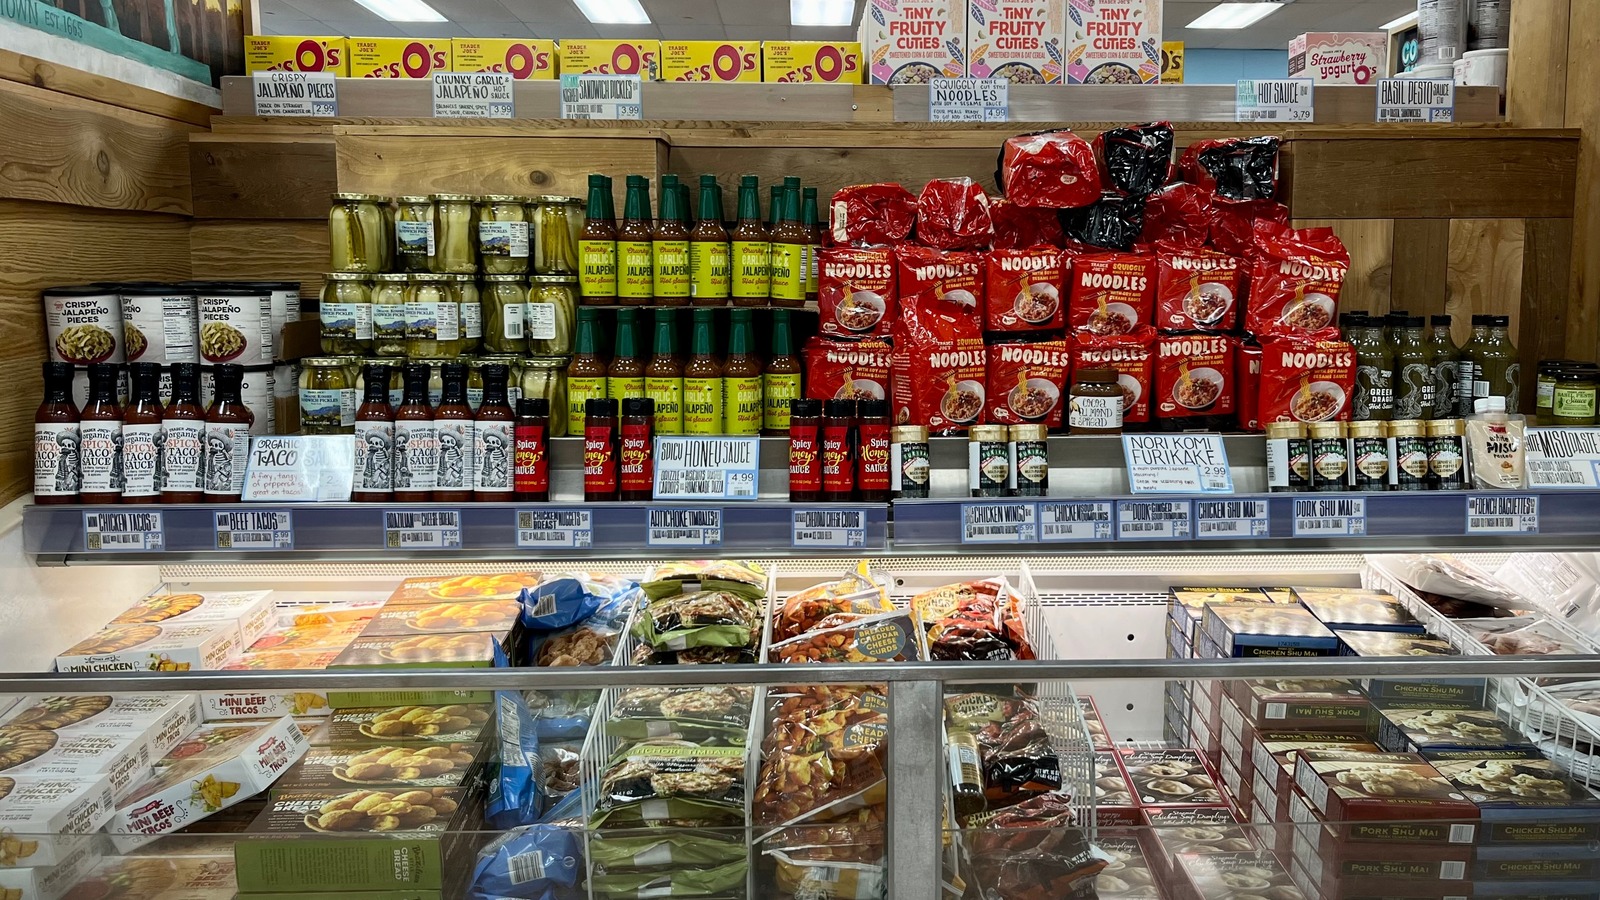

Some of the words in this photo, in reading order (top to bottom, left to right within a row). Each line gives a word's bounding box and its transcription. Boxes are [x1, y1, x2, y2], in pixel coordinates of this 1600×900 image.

[63, 14, 84, 39] 1665
[888, 51, 911, 59] SWEETENED
[1310, 49, 1368, 67] Strawberry
[1320, 61, 1356, 80] yogurt
[271, 73, 307, 82] CRISPY
[435, 75, 472, 84] CHUNKY
[475, 75, 504, 85] GARLIC
[579, 79, 610, 100] SANDWICH
[610, 79, 633, 100] PICKLES
[933, 79, 977, 90] SQUIGGLY
[257, 82, 305, 99] JALAPEÑO
[307, 83, 335, 99] PIECES
[436, 85, 488, 99] JALAPEÑO
[936, 89, 998, 102] NOODLES
[1258, 82, 1273, 104] HOT
[1274, 82, 1299, 104] SAUCE
[1381, 80, 1406, 105] BASIL
[1408, 81, 1433, 105] PESTO
[316, 104, 334, 113] 2.99
[494, 104, 512, 113] 3.99
[621, 106, 639, 114] 3.99
[988, 108, 1006, 117] 4.99
[1434, 109, 1452, 118] 2.99
[1293, 110, 1311, 119] 3.79
[584, 255, 608, 265] GARLIC
[825, 262, 892, 280] NOODLES
[1081, 272, 1147, 292] NOODLES
[65, 301, 98, 309] CRISPY
[61, 306, 109, 317] JALAPEÑO
[67, 315, 99, 324] PIECES
[1160, 339, 1228, 357] NOODLES
[1281, 350, 1352, 370] NOODLES
[82, 440, 110, 449] SPICY
[124, 444, 153, 453] SPICY
[167, 439, 197, 448] SPICY
[257, 439, 300, 450] ORGANIC
[517, 439, 538, 451] Spicy
[624, 438, 645, 450] Spicy
[792, 438, 812, 450] Spicy
[1130, 436, 1169, 450] NORI
[1172, 436, 1212, 450] KOMI
[1537, 430, 1573, 458] MISO
[82, 448, 110, 457] TACO
[125, 452, 152, 462] TACO
[167, 447, 196, 457] TACO
[661, 442, 683, 461] SPICY
[684, 440, 722, 468] HONEY
[722, 441, 751, 464] SAUCE
[1131, 449, 1215, 466] FURIKAKE
[82, 456, 111, 466] SAUCE
[167, 456, 198, 465] SAUCE
[253, 449, 298, 467] TACO
[125, 461, 154, 470] SAUCE
[1204, 466, 1226, 476] 2.99
[731, 473, 754, 482] 4.99
[1198, 502, 1226, 520] CHICKEN
[1227, 501, 1241, 519] SHU
[1296, 499, 1317, 517] PORK
[1319, 499, 1336, 517] SHU
[1337, 499, 1353, 517] MAI
[533, 511, 559, 521] CHICKEN
[974, 505, 1004, 524] CHICKEN
[98, 513, 128, 532] CHICKEN
[128, 512, 151, 532] TACOS
[230, 512, 250, 531] BEEF
[250, 512, 278, 531] TACOS
[533, 520, 557, 530] BREAST
[858, 626, 895, 643] BREADED
[859, 633, 900, 650] CHEDDAR
[866, 640, 898, 657] CHEESE
[1253, 648, 1287, 656] CHICKEN
[1303, 649, 1319, 657] MAI
[870, 648, 898, 662] CURDS
[1394, 684, 1429, 693] CHICKEN
[1430, 686, 1448, 694] SHU
[1449, 687, 1465, 695] MAI
[218, 696, 244, 707] MINI
[245, 695, 267, 706] BEEF
[229, 705, 259, 715] TACOS
[274, 799, 322, 807] CHEESE
[272, 805, 321, 813] BREAD
[126, 815, 151, 834] MINI
[153, 803, 176, 821] BEEF
[1360, 826, 1388, 836] PORK
[1391, 826, 1416, 836] SHU
[1418, 828, 1439, 837] MAI
[1504, 826, 1546, 834] CHICKEN
[1547, 826, 1568, 834] SHU
[1568, 826, 1586, 834] MAI
[393, 847, 402, 881] BREAD
[400, 846, 410, 882] CHEESE
[1350, 864, 1379, 873] PORK
[1382, 865, 1407, 874] SHU
[1409, 865, 1430, 874] MAI
[1499, 863, 1541, 871] CHICKEN
[1541, 863, 1564, 871] SHU
[1563, 863, 1581, 871] MAI
